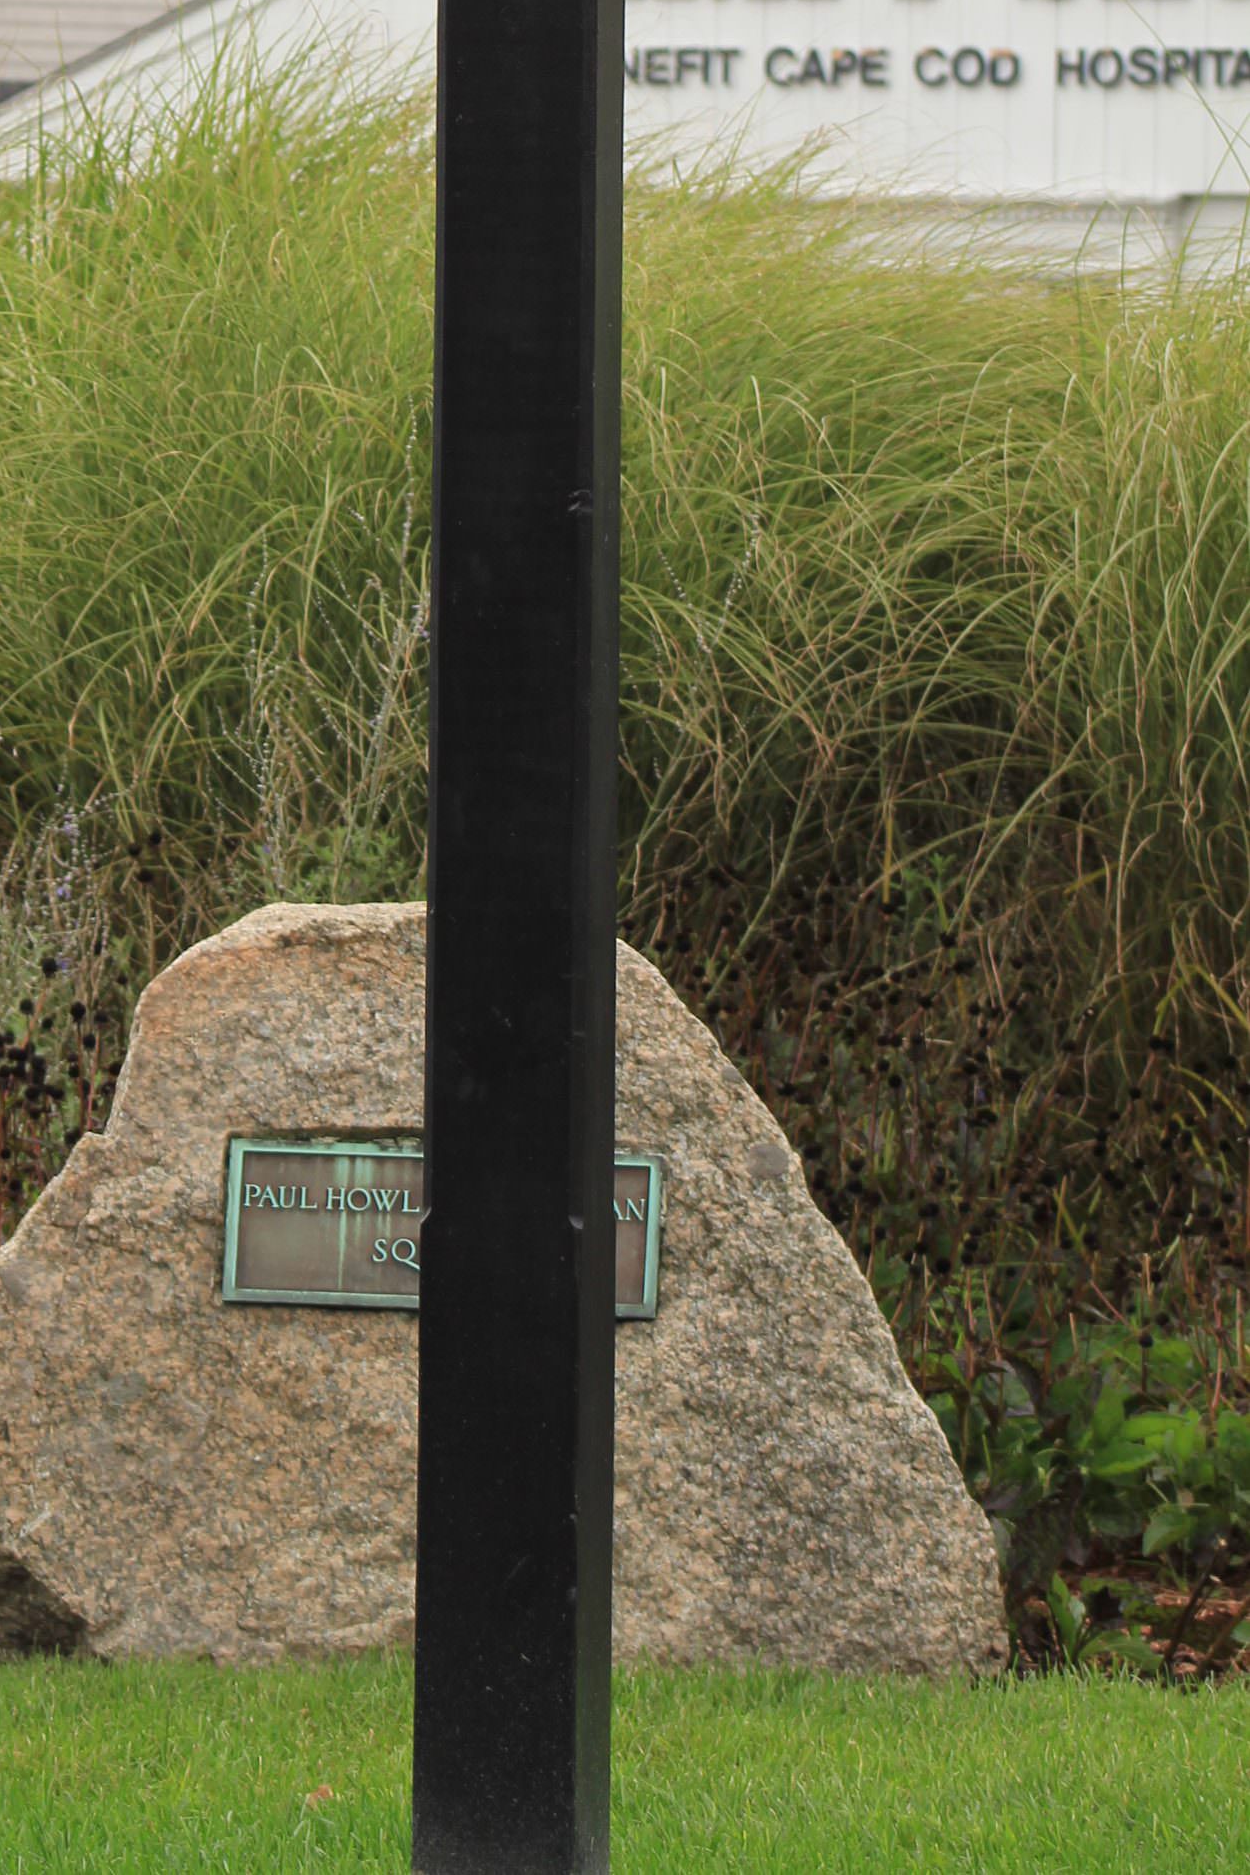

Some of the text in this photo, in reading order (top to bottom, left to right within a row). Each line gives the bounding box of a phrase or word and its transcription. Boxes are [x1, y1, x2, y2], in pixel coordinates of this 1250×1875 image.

[764, 46, 890, 89] CAPE
[913, 46, 1022, 90] COD
[243, 1183, 317, 1210] PAUL
